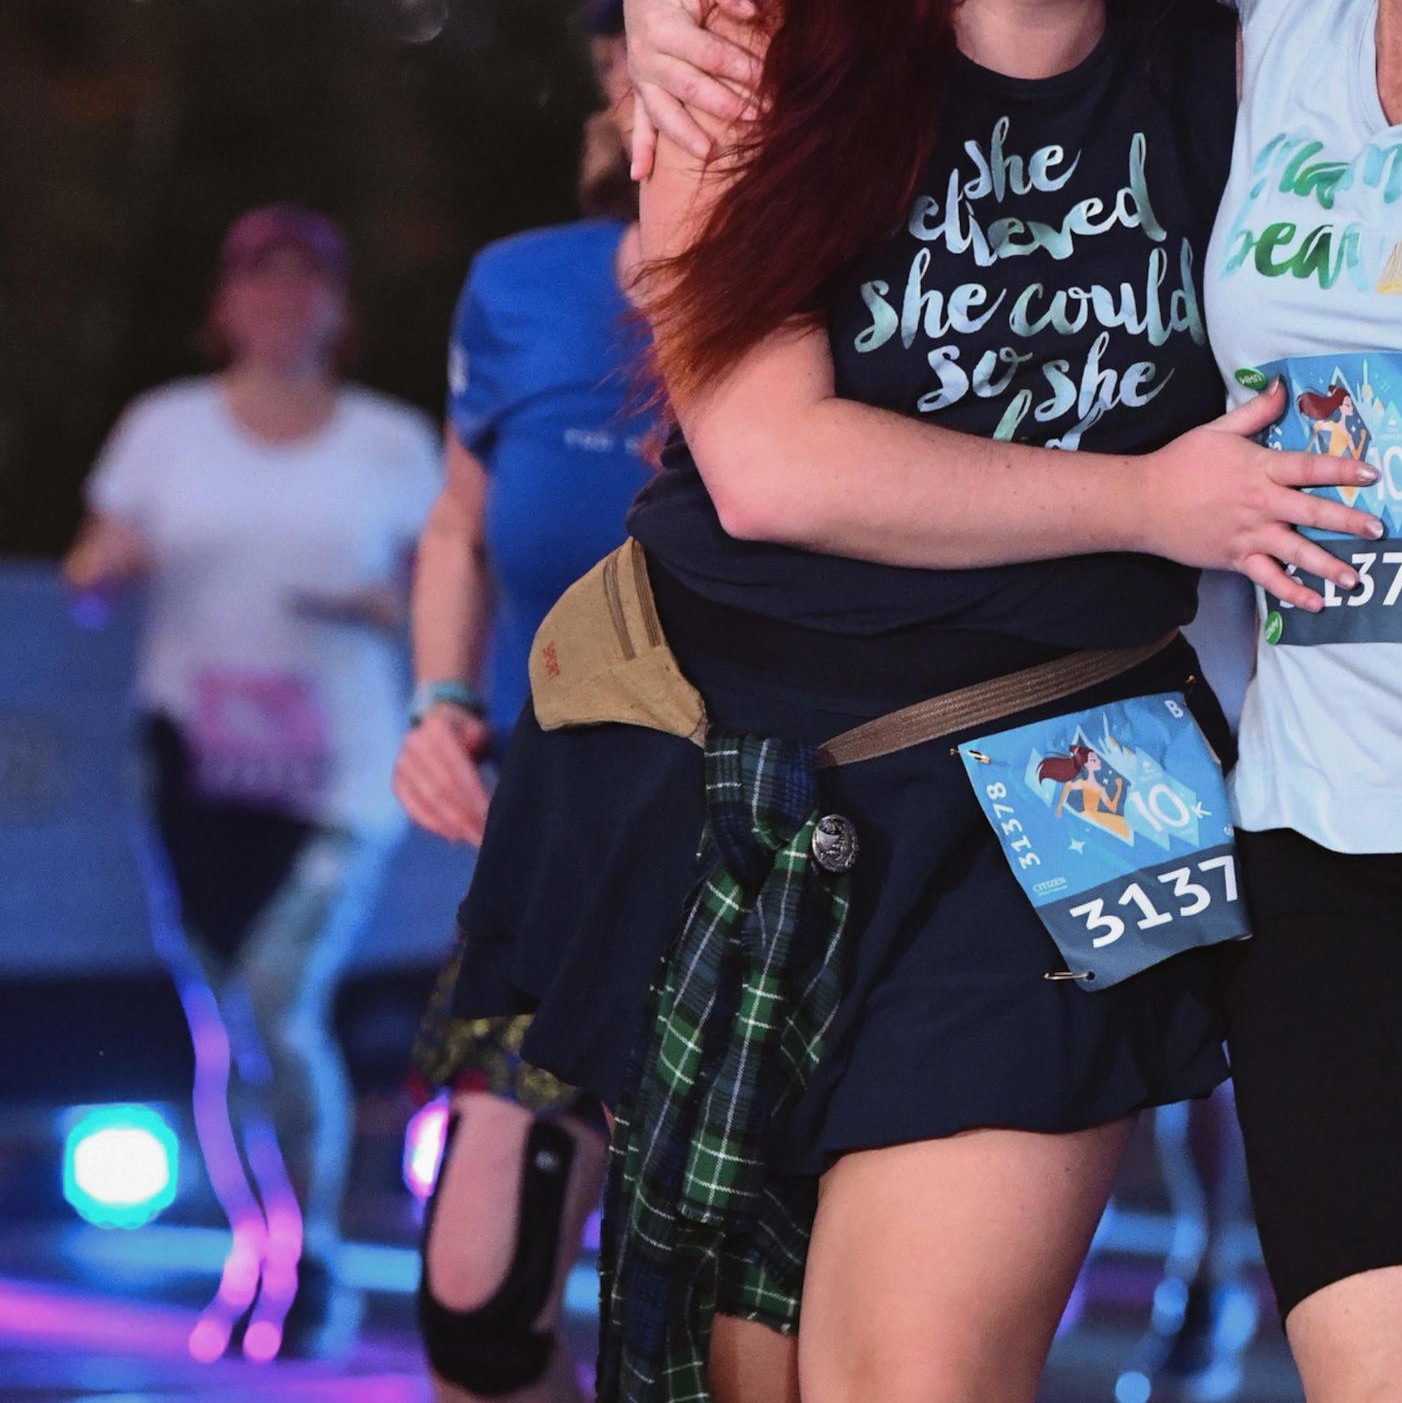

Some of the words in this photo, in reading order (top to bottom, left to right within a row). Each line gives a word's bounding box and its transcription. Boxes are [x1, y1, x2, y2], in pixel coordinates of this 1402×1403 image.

[908, 132, 1167, 266] elieved
[964, 116, 1081, 203] she
[854, 248, 1006, 353] she
[1009, 237, 1205, 346] could
[917, 346, 1033, 413] so
[1034, 331, 1175, 422] she
[1164, 700, 1183, 719] B
[986, 781, 1041, 870] 31378
